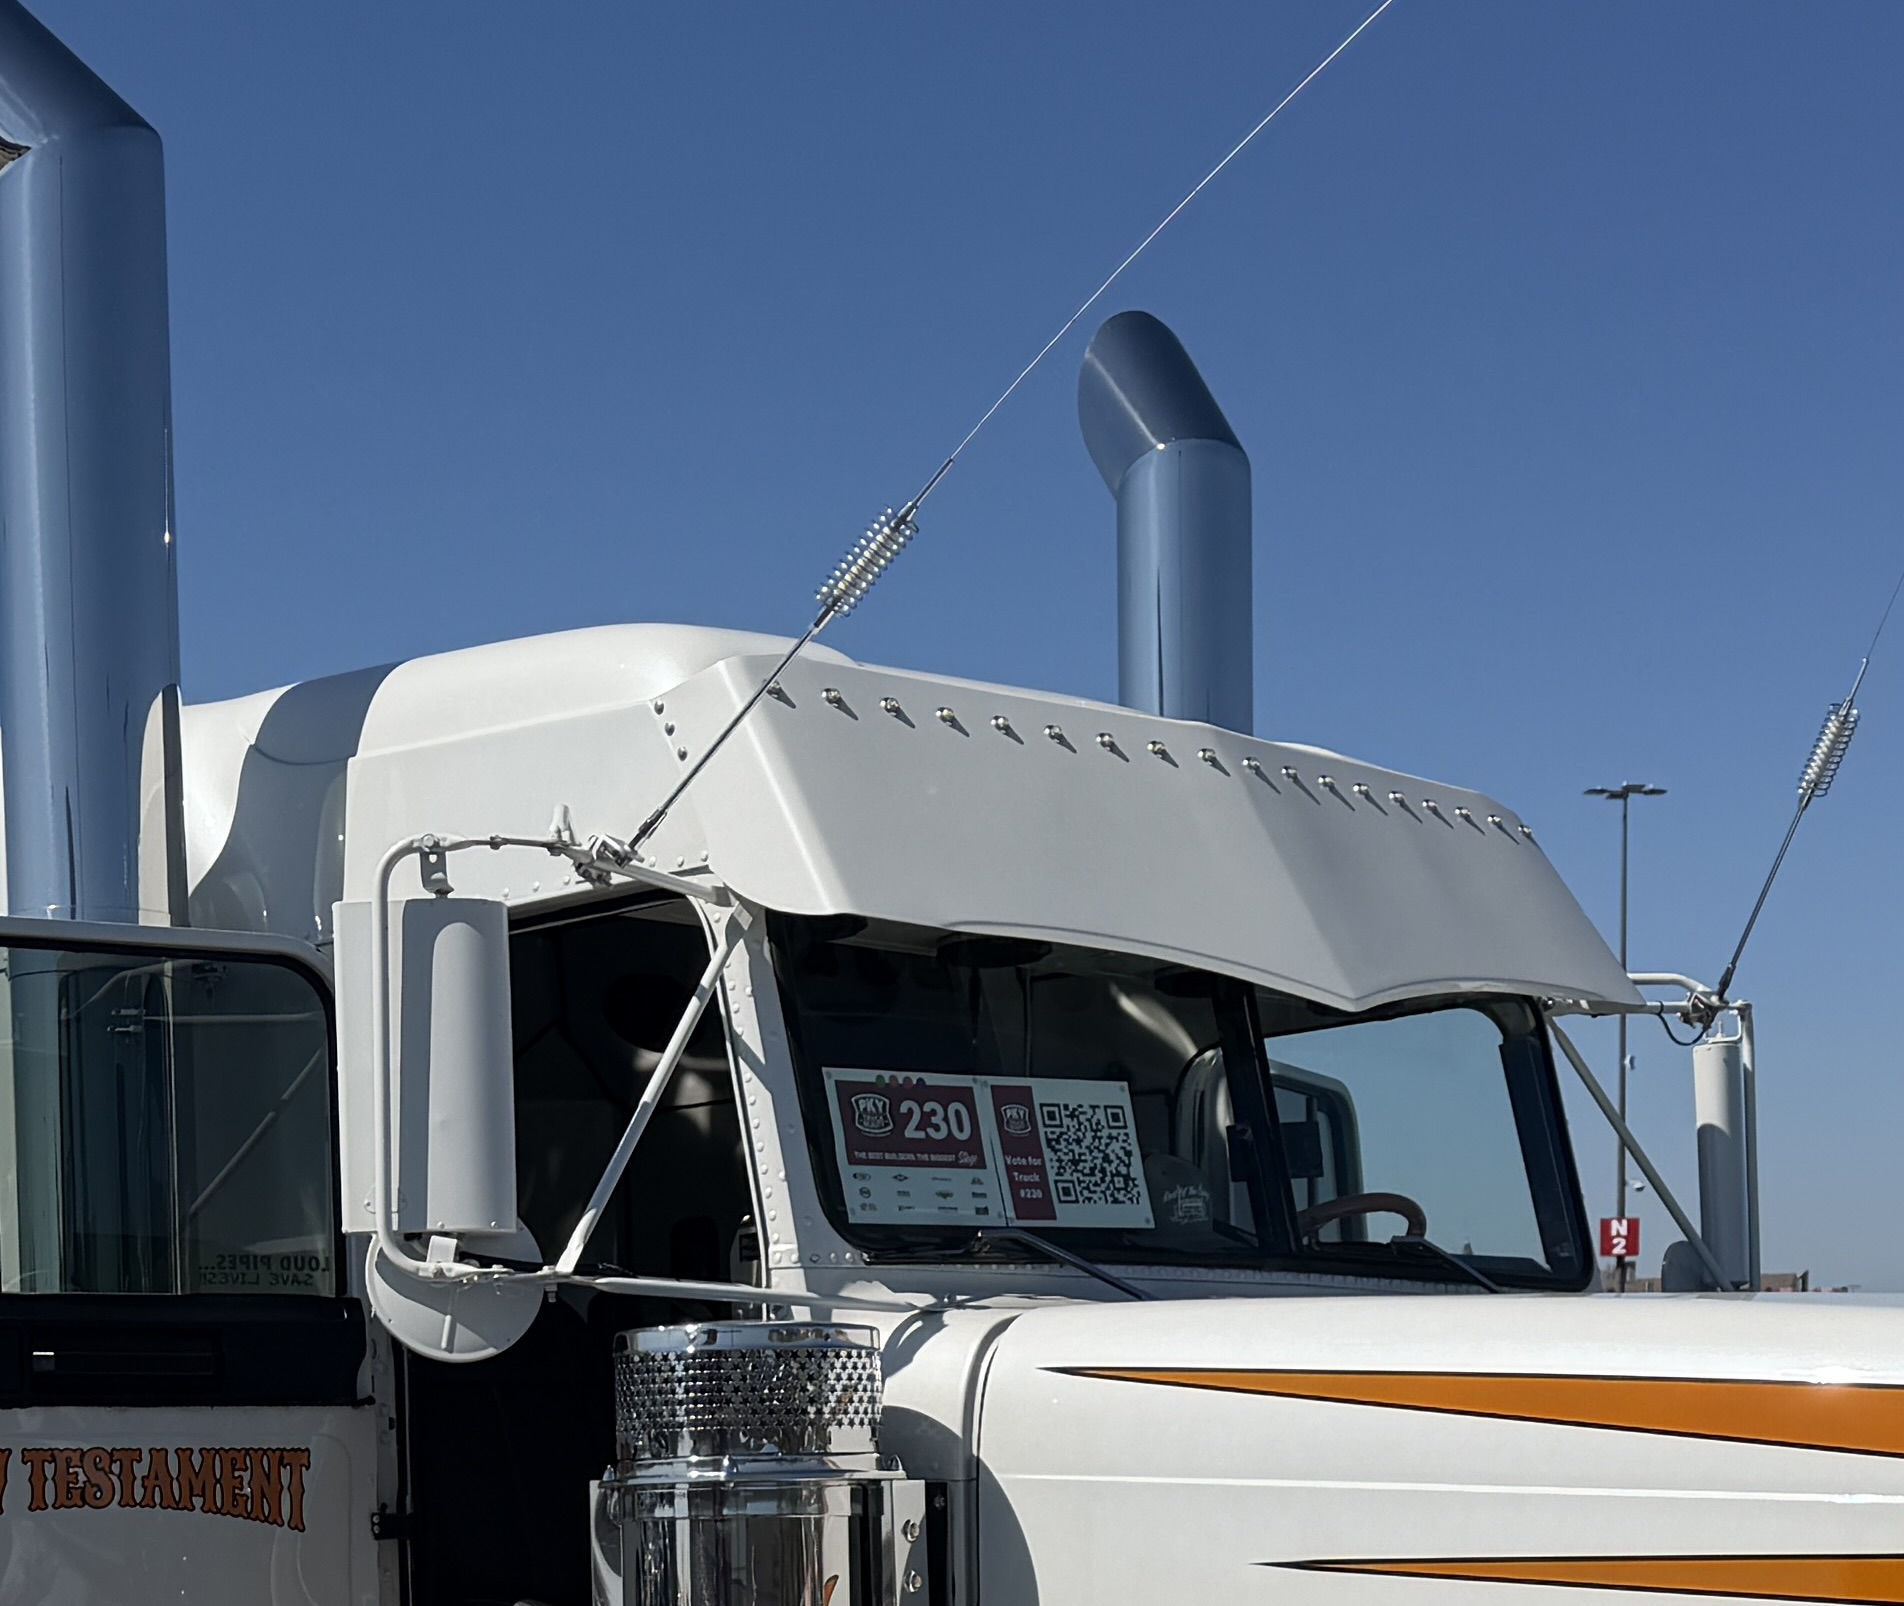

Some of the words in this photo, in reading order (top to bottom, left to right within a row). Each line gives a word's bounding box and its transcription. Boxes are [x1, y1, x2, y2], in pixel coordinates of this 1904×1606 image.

[899, 1100, 972, 1141] 230
[1005, 1155, 1027, 1166] Vote
[1028, 1156, 1042, 1166] for
[1013, 1172, 1040, 1182] Truck
[1020, 1189, 1043, 1199] #230
[1611, 1219, 1628, 1236] N
[1612, 1237, 1626, 1254] 2
[21, 1447, 311, 1532] TESTAMENT
